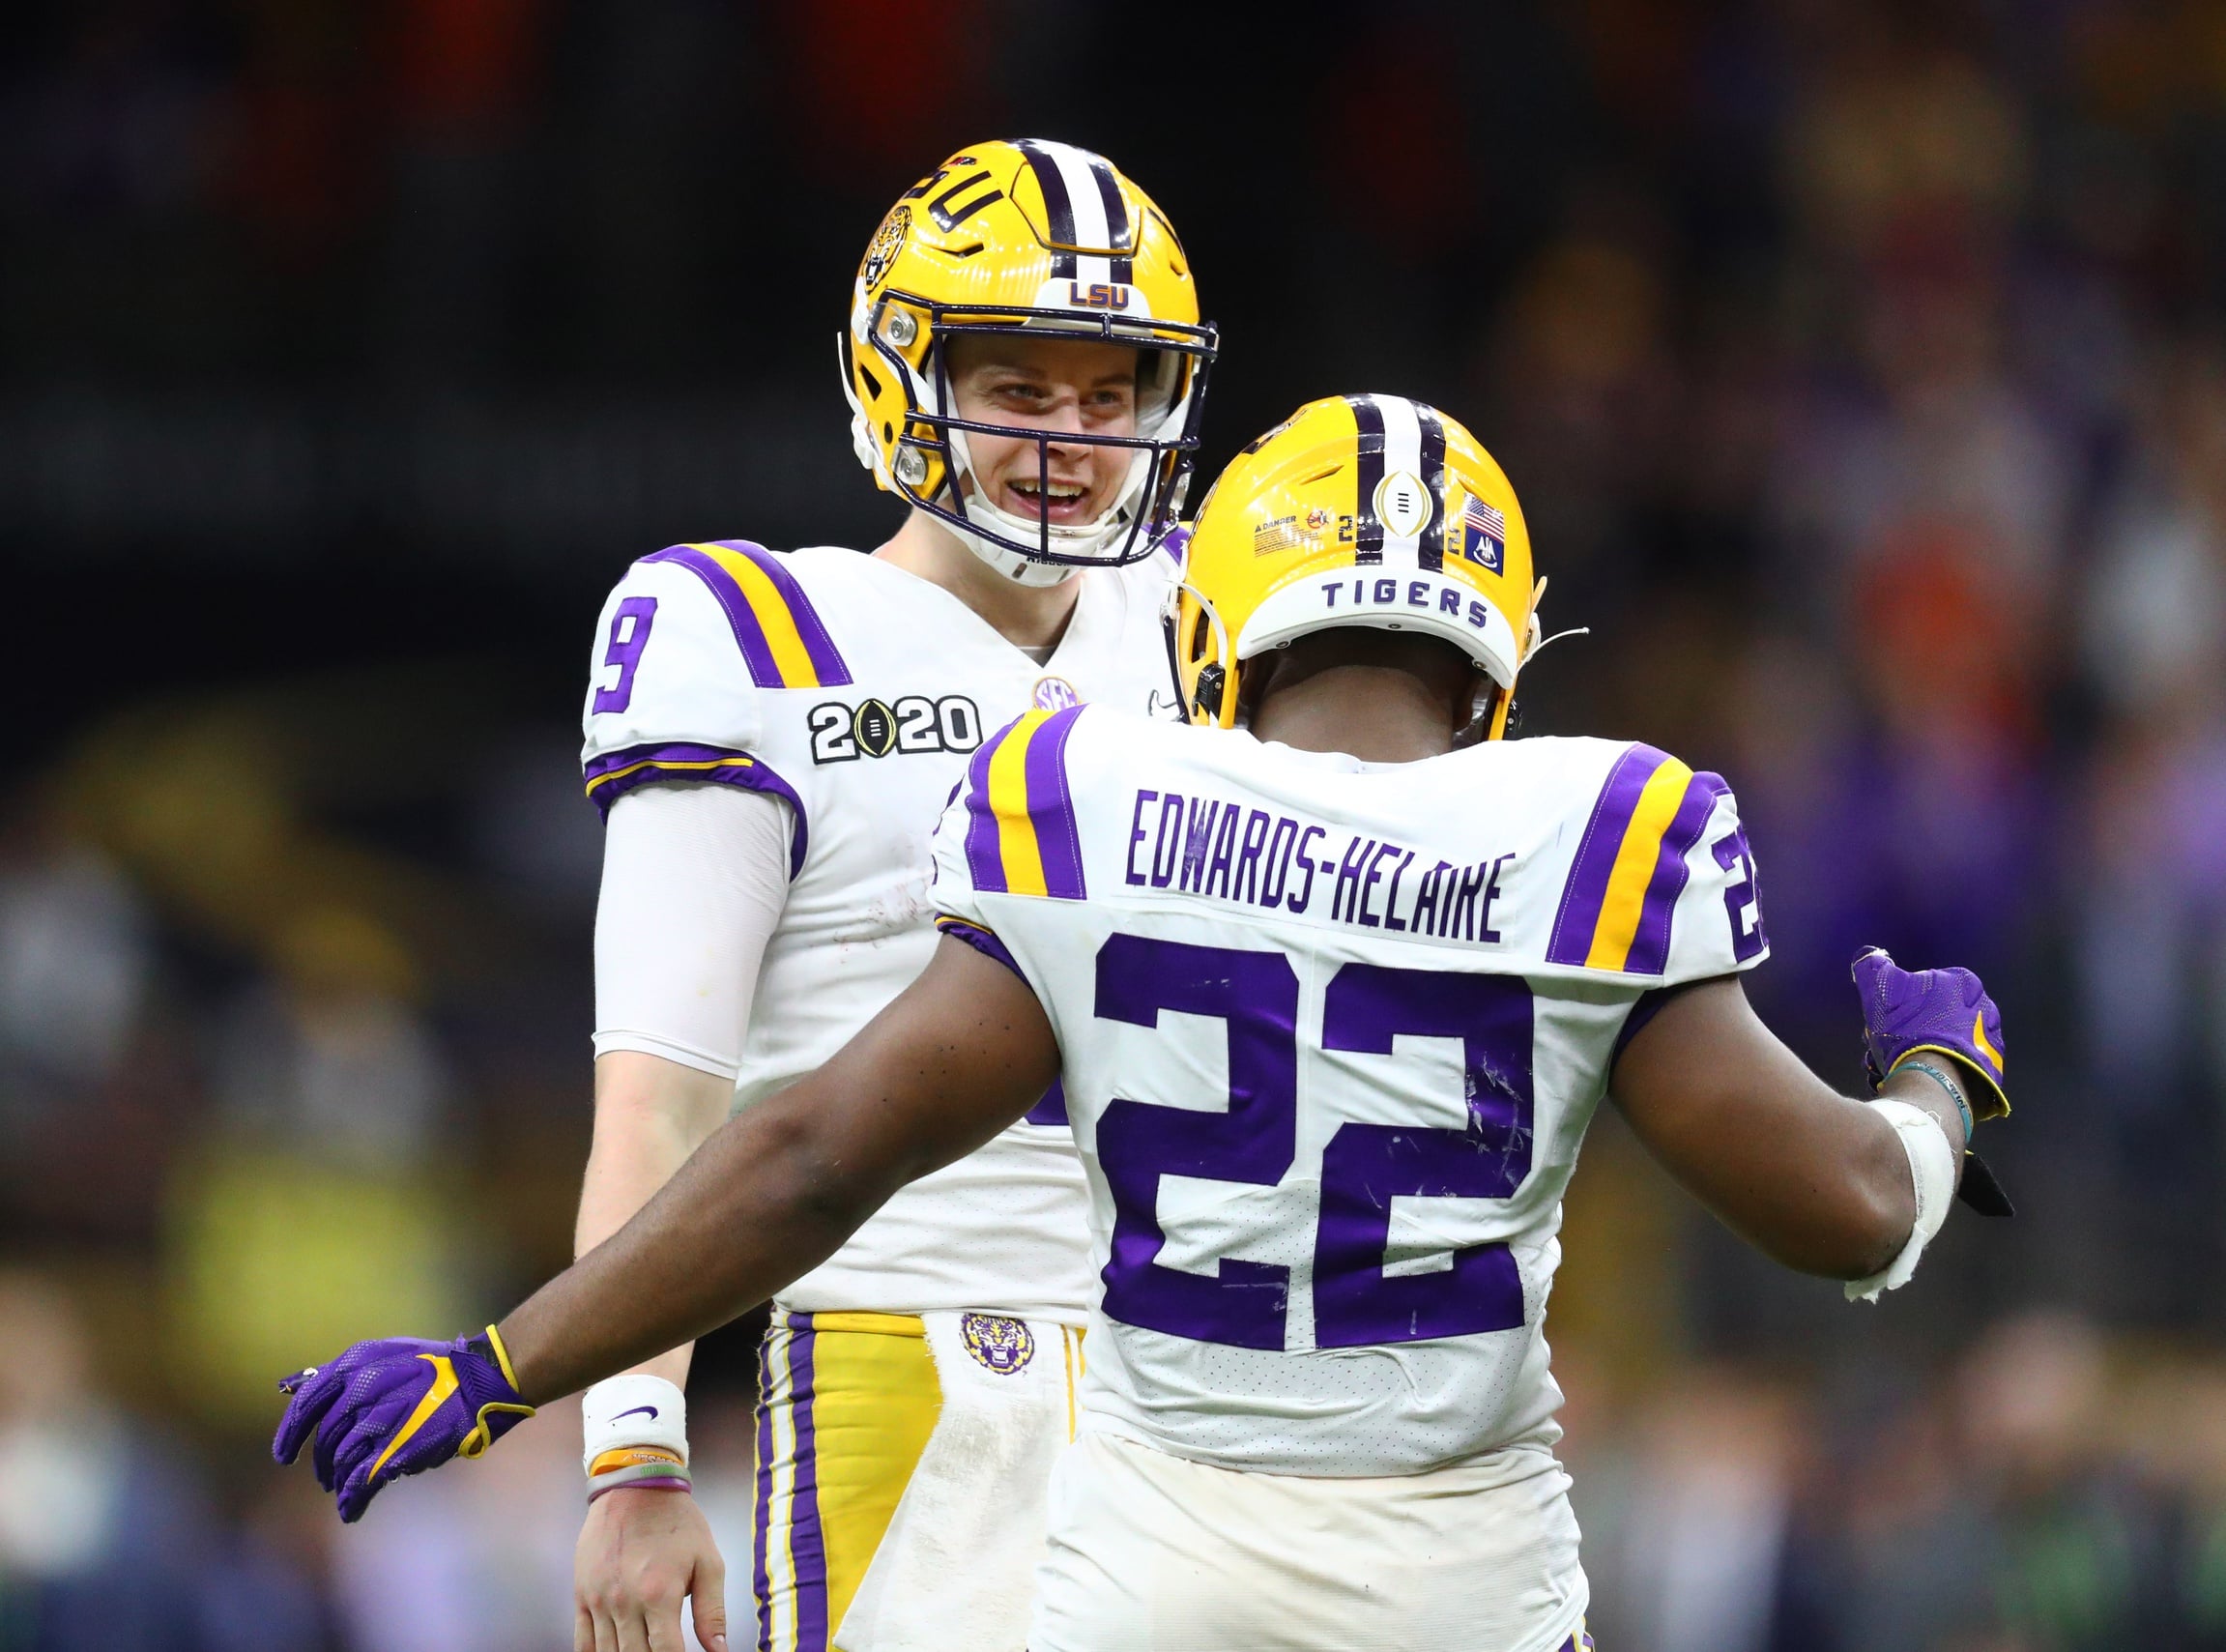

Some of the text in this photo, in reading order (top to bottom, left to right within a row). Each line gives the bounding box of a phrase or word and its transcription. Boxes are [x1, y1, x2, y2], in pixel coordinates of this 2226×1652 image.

[1069, 282, 1129, 310] LSU
[1262, 515, 1296, 530] DANGER
[1339, 515, 1353, 541] 2
[1321, 580, 1489, 628] TIGERS
[592, 596, 657, 716] 9
[1125, 789, 1516, 943] EDWARDS-HELAIRE
[1094, 932, 1535, 1351] 22
